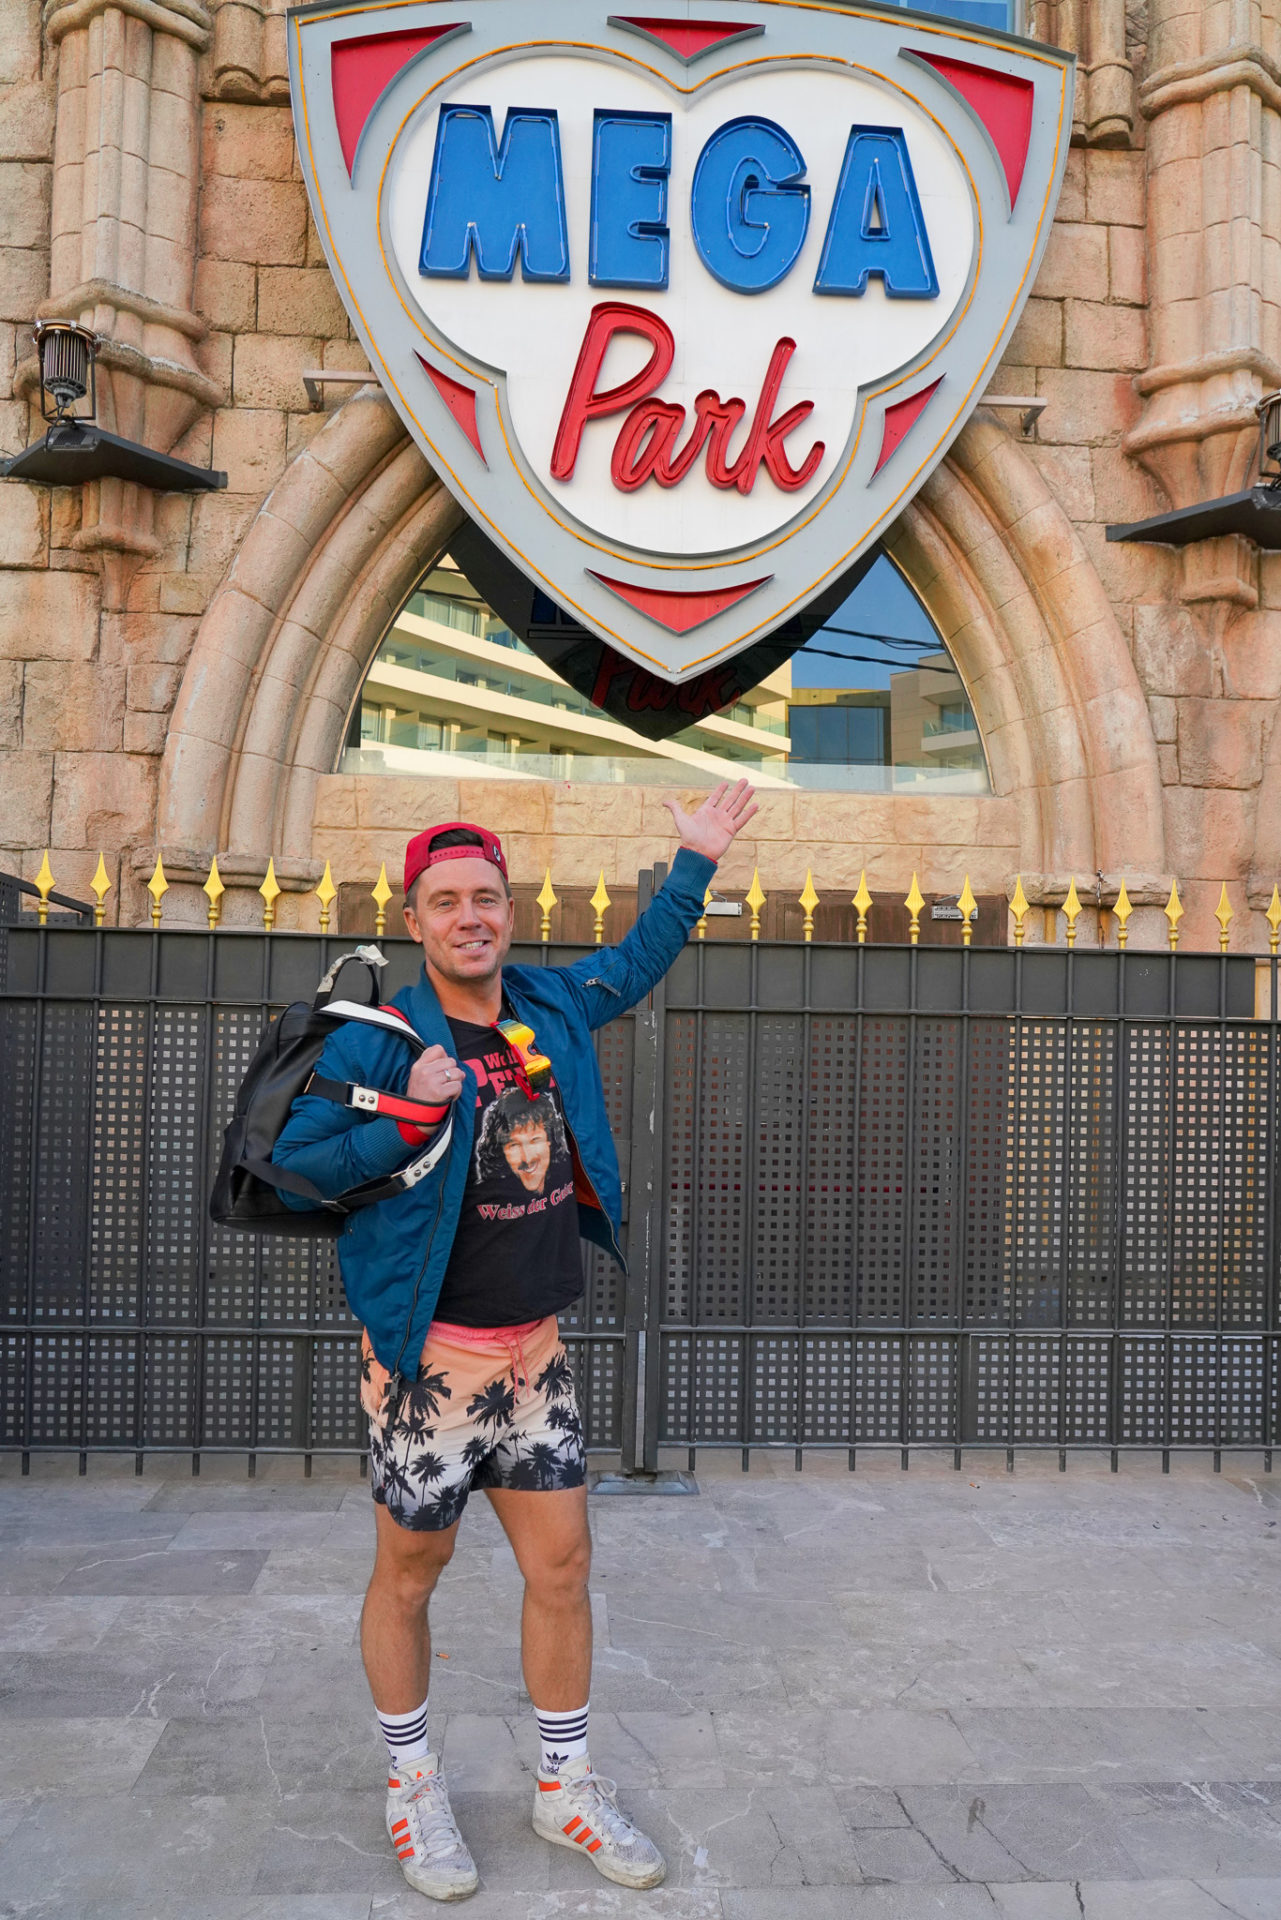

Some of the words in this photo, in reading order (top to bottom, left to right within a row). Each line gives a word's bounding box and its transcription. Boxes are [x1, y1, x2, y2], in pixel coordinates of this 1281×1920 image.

[418, 102, 941, 300] MEGA
[550, 301, 826, 495] Park
[476, 1202, 526, 1221] Weiss
[526, 1197, 548, 1215] der
